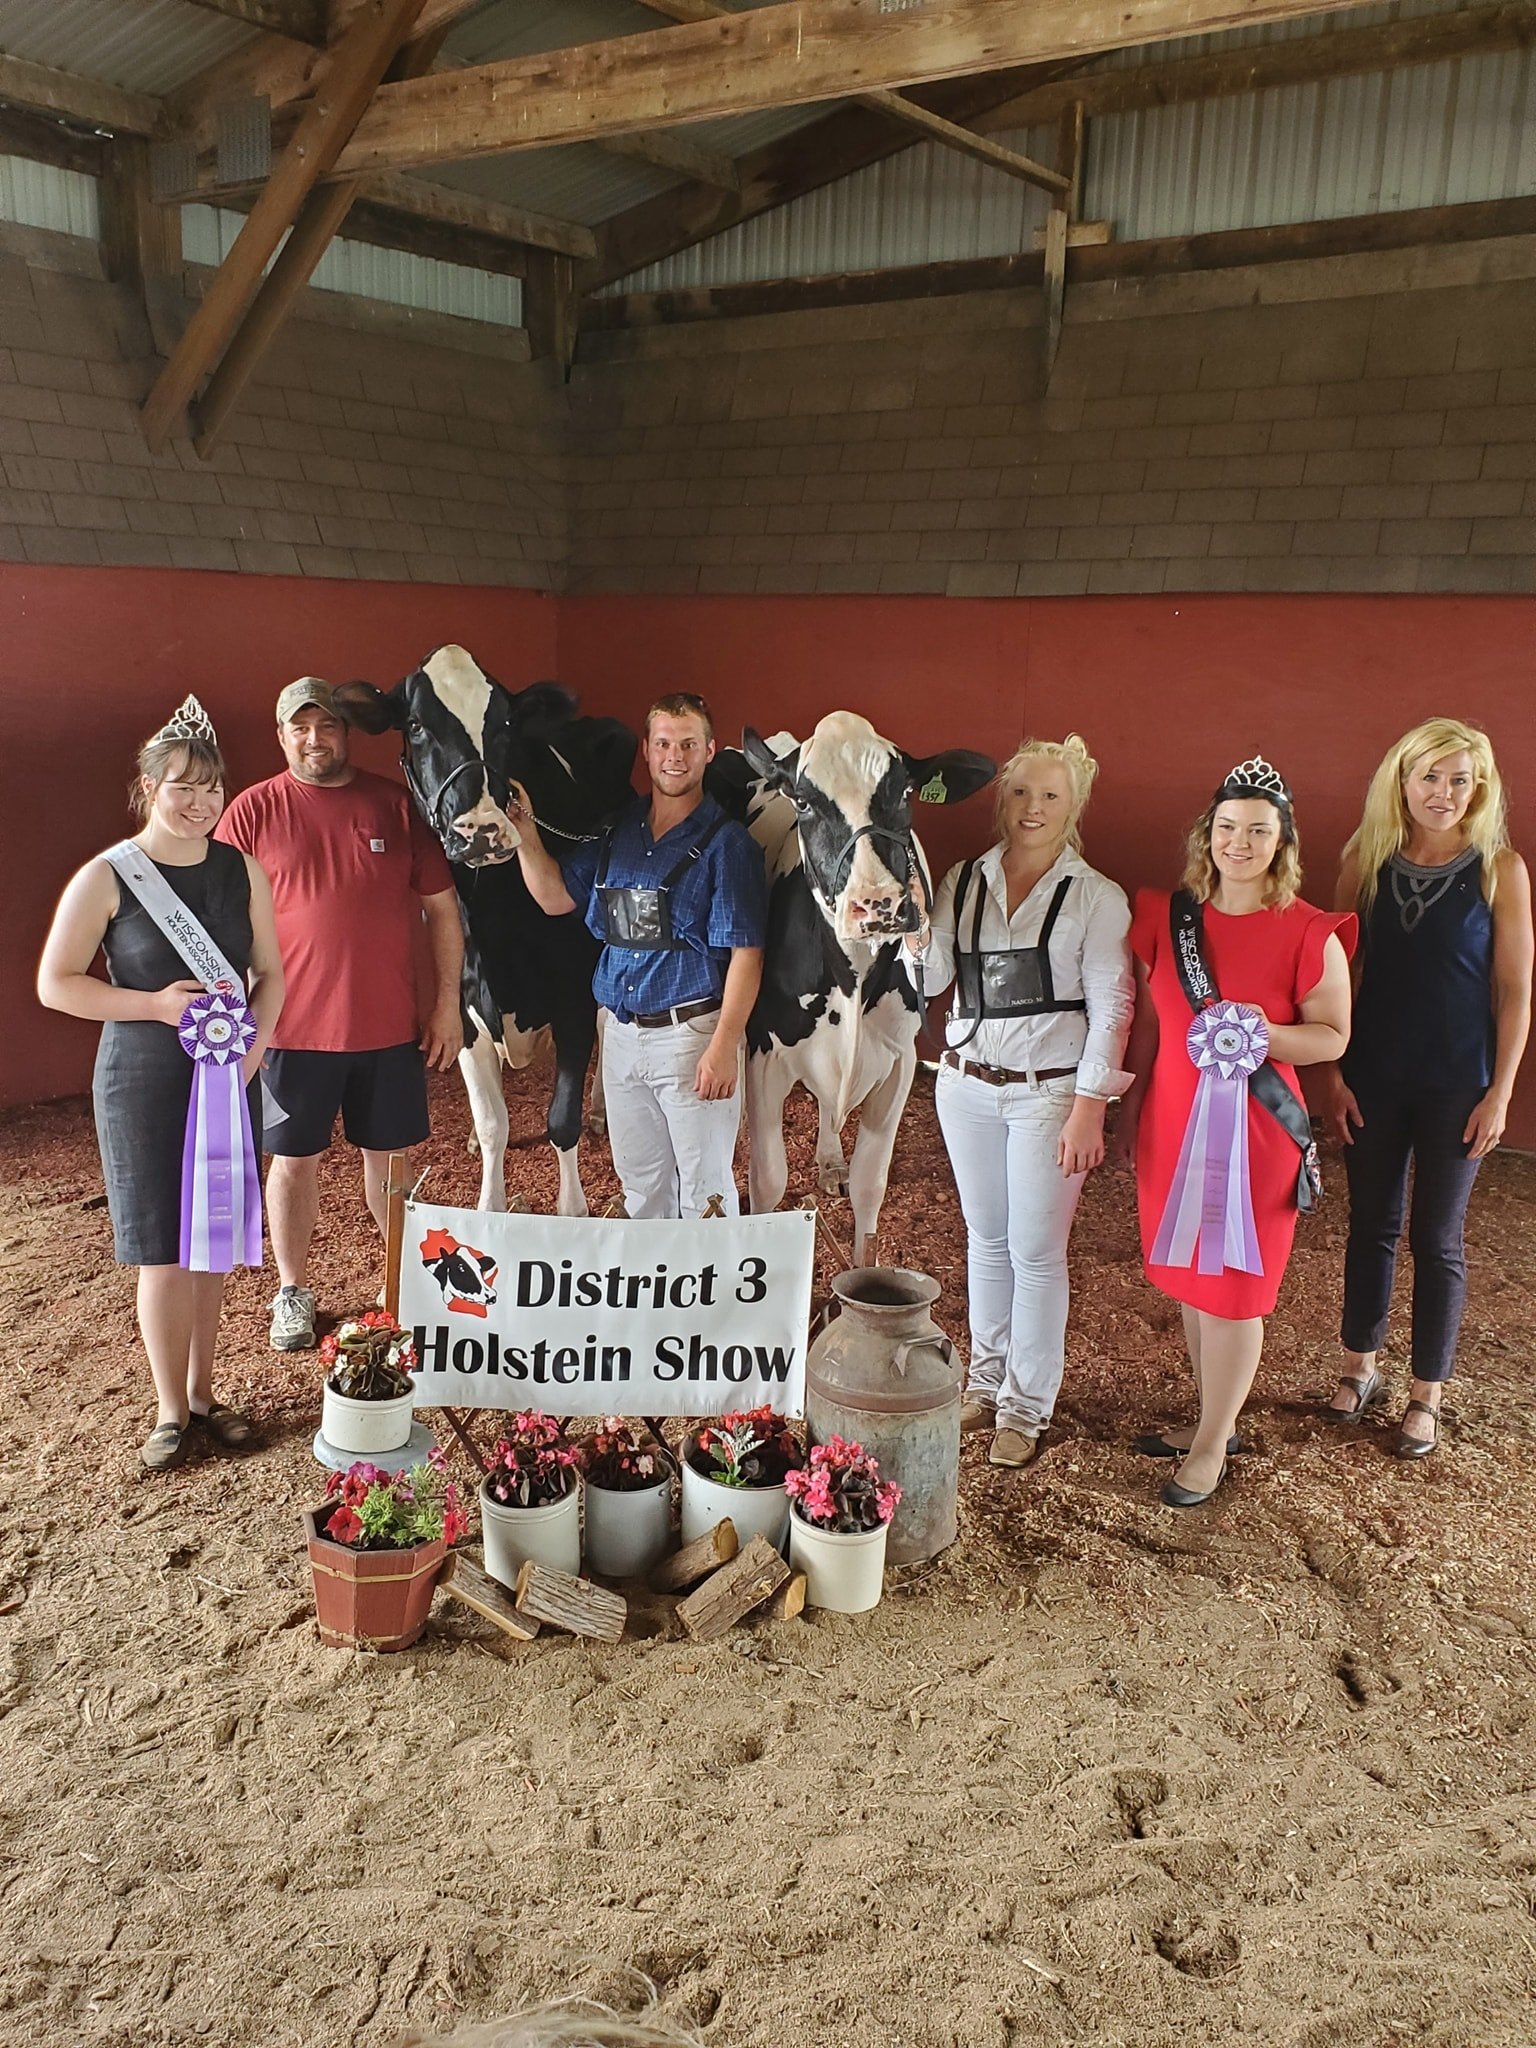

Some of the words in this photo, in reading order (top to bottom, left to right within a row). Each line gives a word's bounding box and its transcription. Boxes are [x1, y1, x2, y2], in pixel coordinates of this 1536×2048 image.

[165, 915, 190, 946] HOLSTEIN
[187, 945, 216, 982] ASSOCIATION
[174, 910, 225, 977] WISCONSIN
[1186, 926, 1212, 997] WISCONSIN
[516, 1259, 719, 1309] District
[735, 1257, 768, 1304] 3
[411, 1325, 632, 1384] Holstein
[652, 1334, 796, 1383] Show
